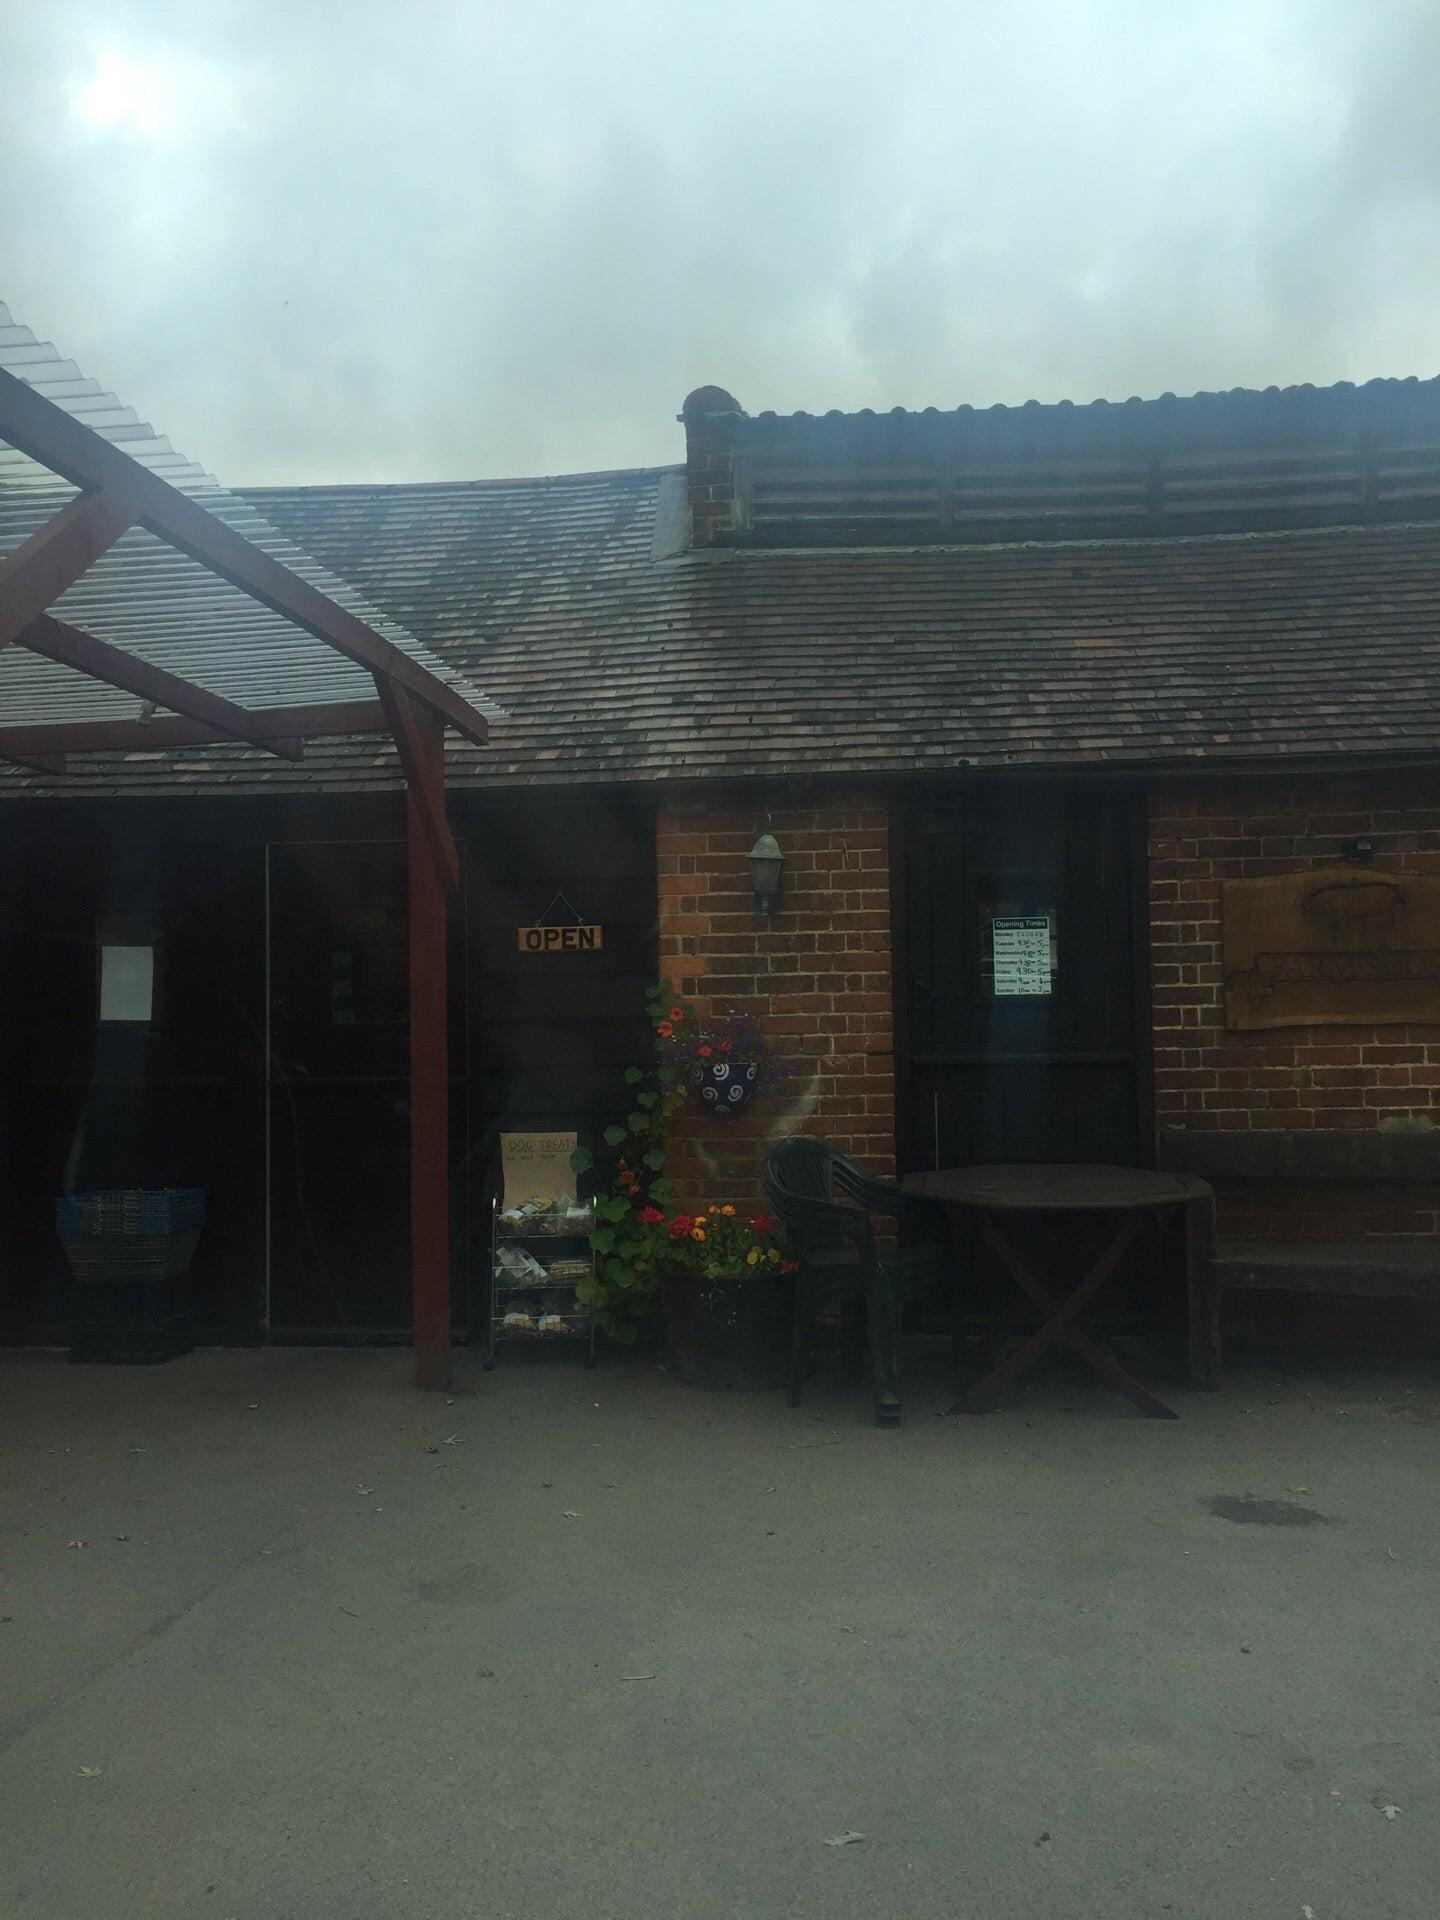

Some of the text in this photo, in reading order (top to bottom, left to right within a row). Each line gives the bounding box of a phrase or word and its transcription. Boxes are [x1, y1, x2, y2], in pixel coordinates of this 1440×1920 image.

[996, 920, 1024, 928] Opening
[525, 928, 595, 950] OPEN
[508, 1137, 577, 1151] DOG TREATS
